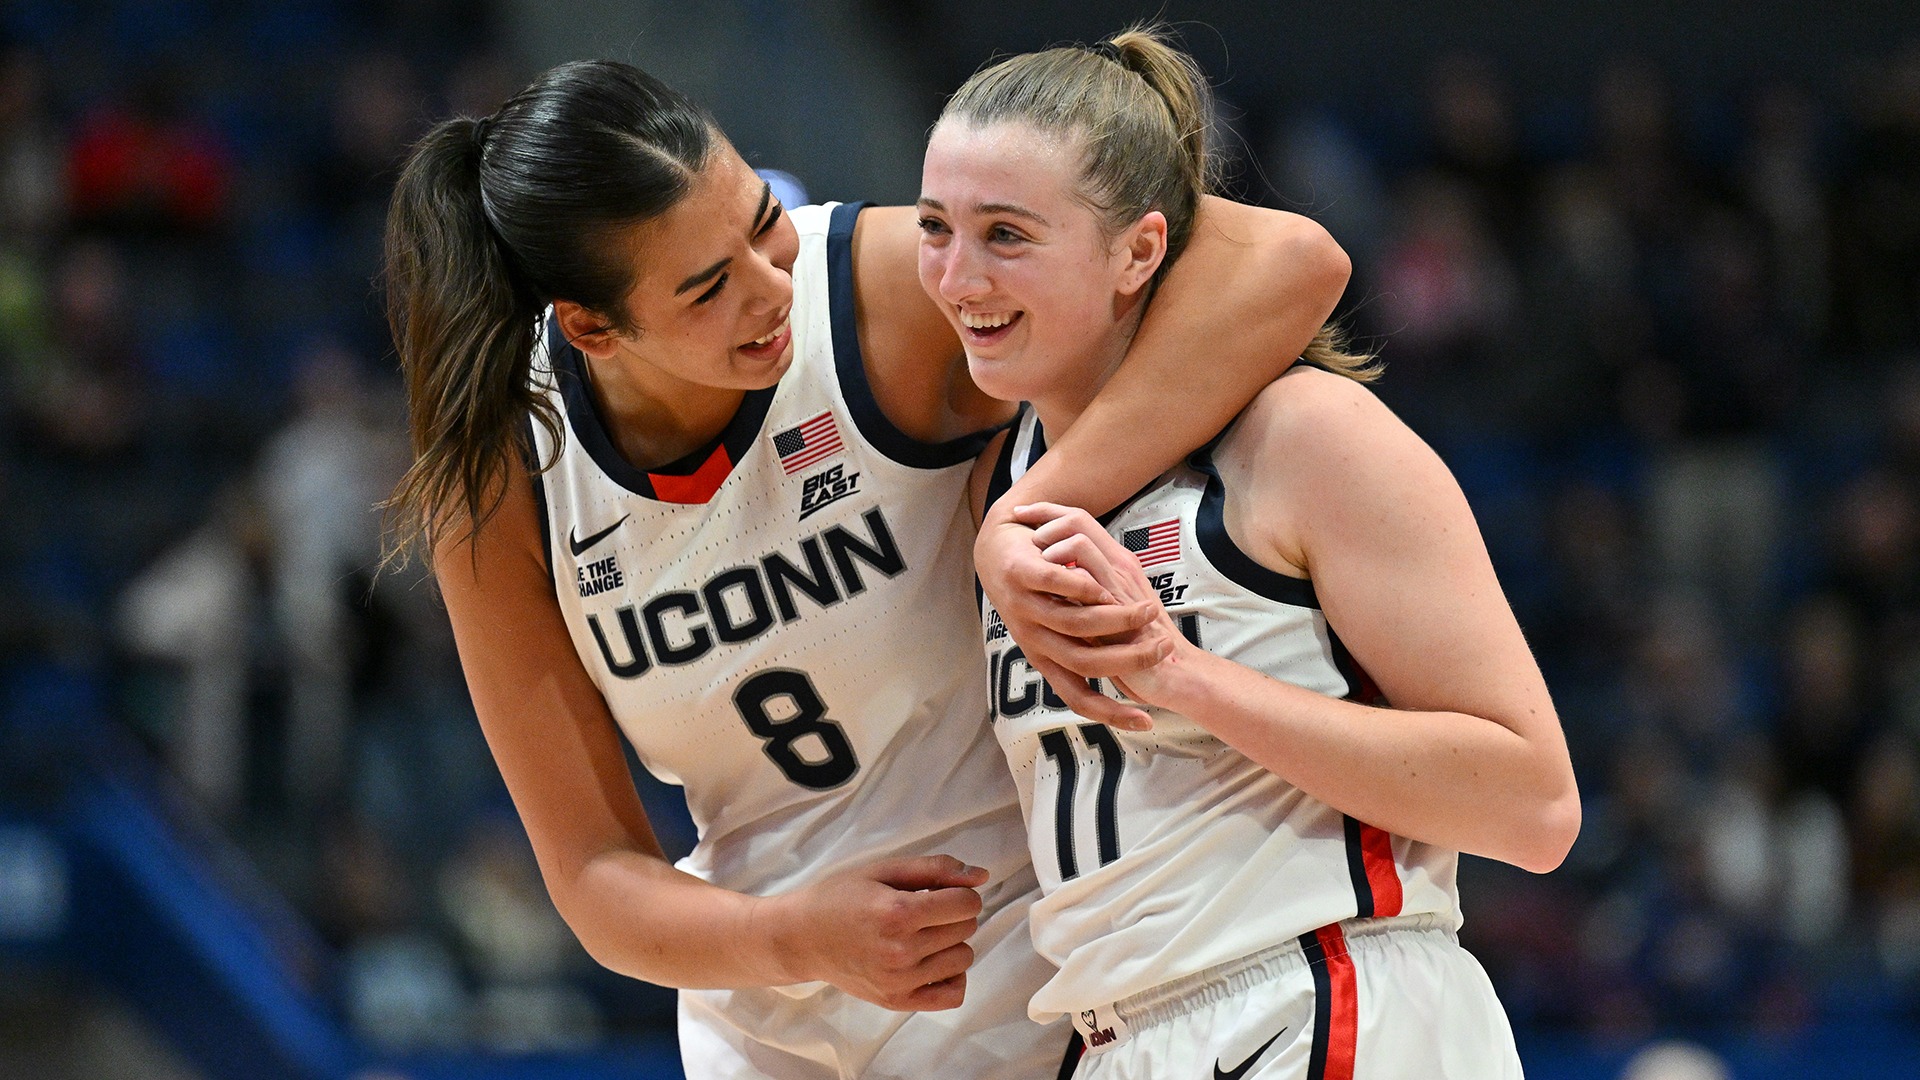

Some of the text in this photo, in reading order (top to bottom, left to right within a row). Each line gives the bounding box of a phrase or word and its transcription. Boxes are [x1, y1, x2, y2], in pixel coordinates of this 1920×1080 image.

[801, 472, 860, 512] EAST
[803, 463, 844, 496] BIG
[586, 556, 617, 579] THE
[1147, 571, 1175, 590] IG
[578, 571, 624, 598] HANGE
[586, 505, 908, 680] UCONN
[1159, 584, 1189, 604] ST
[731, 667, 860, 791] 8
[1037, 723, 1126, 882] 11
